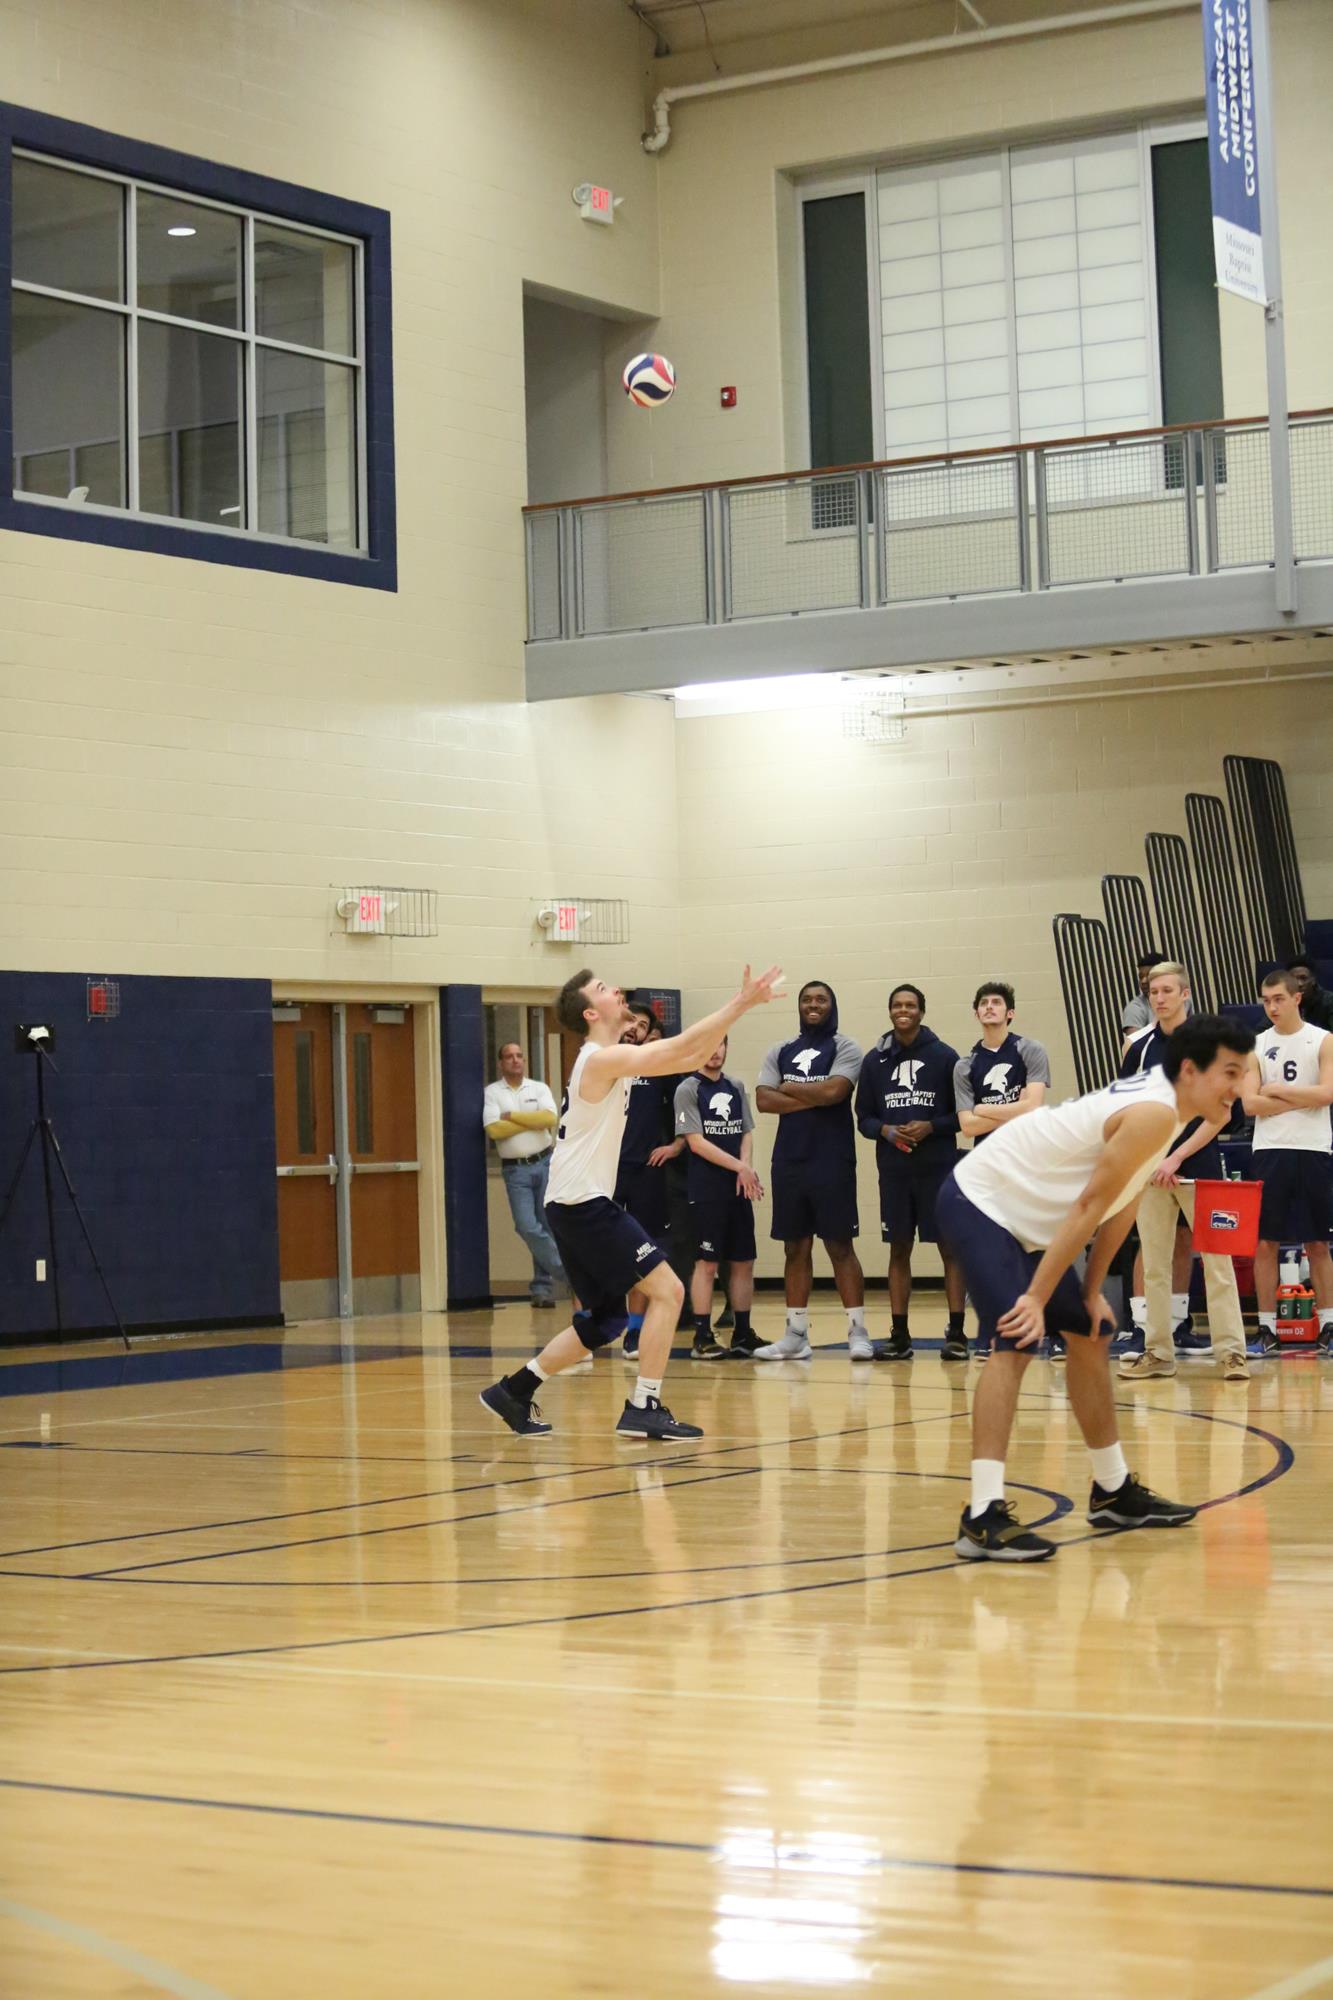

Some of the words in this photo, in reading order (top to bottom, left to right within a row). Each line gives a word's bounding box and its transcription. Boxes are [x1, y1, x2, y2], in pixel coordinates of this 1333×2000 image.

[1213, 0, 1229, 164] AMERICAN
[1225, 8, 1241, 159] MIDWEST
[1237, 0, 1256, 197] CONFERENC
[360, 895, 381, 921] EXIT
[559, 906, 577, 931] EXIT
[1283, 1060, 1297, 1082] 6
[704, 1126, 743, 1135] VOLLEYBAL
